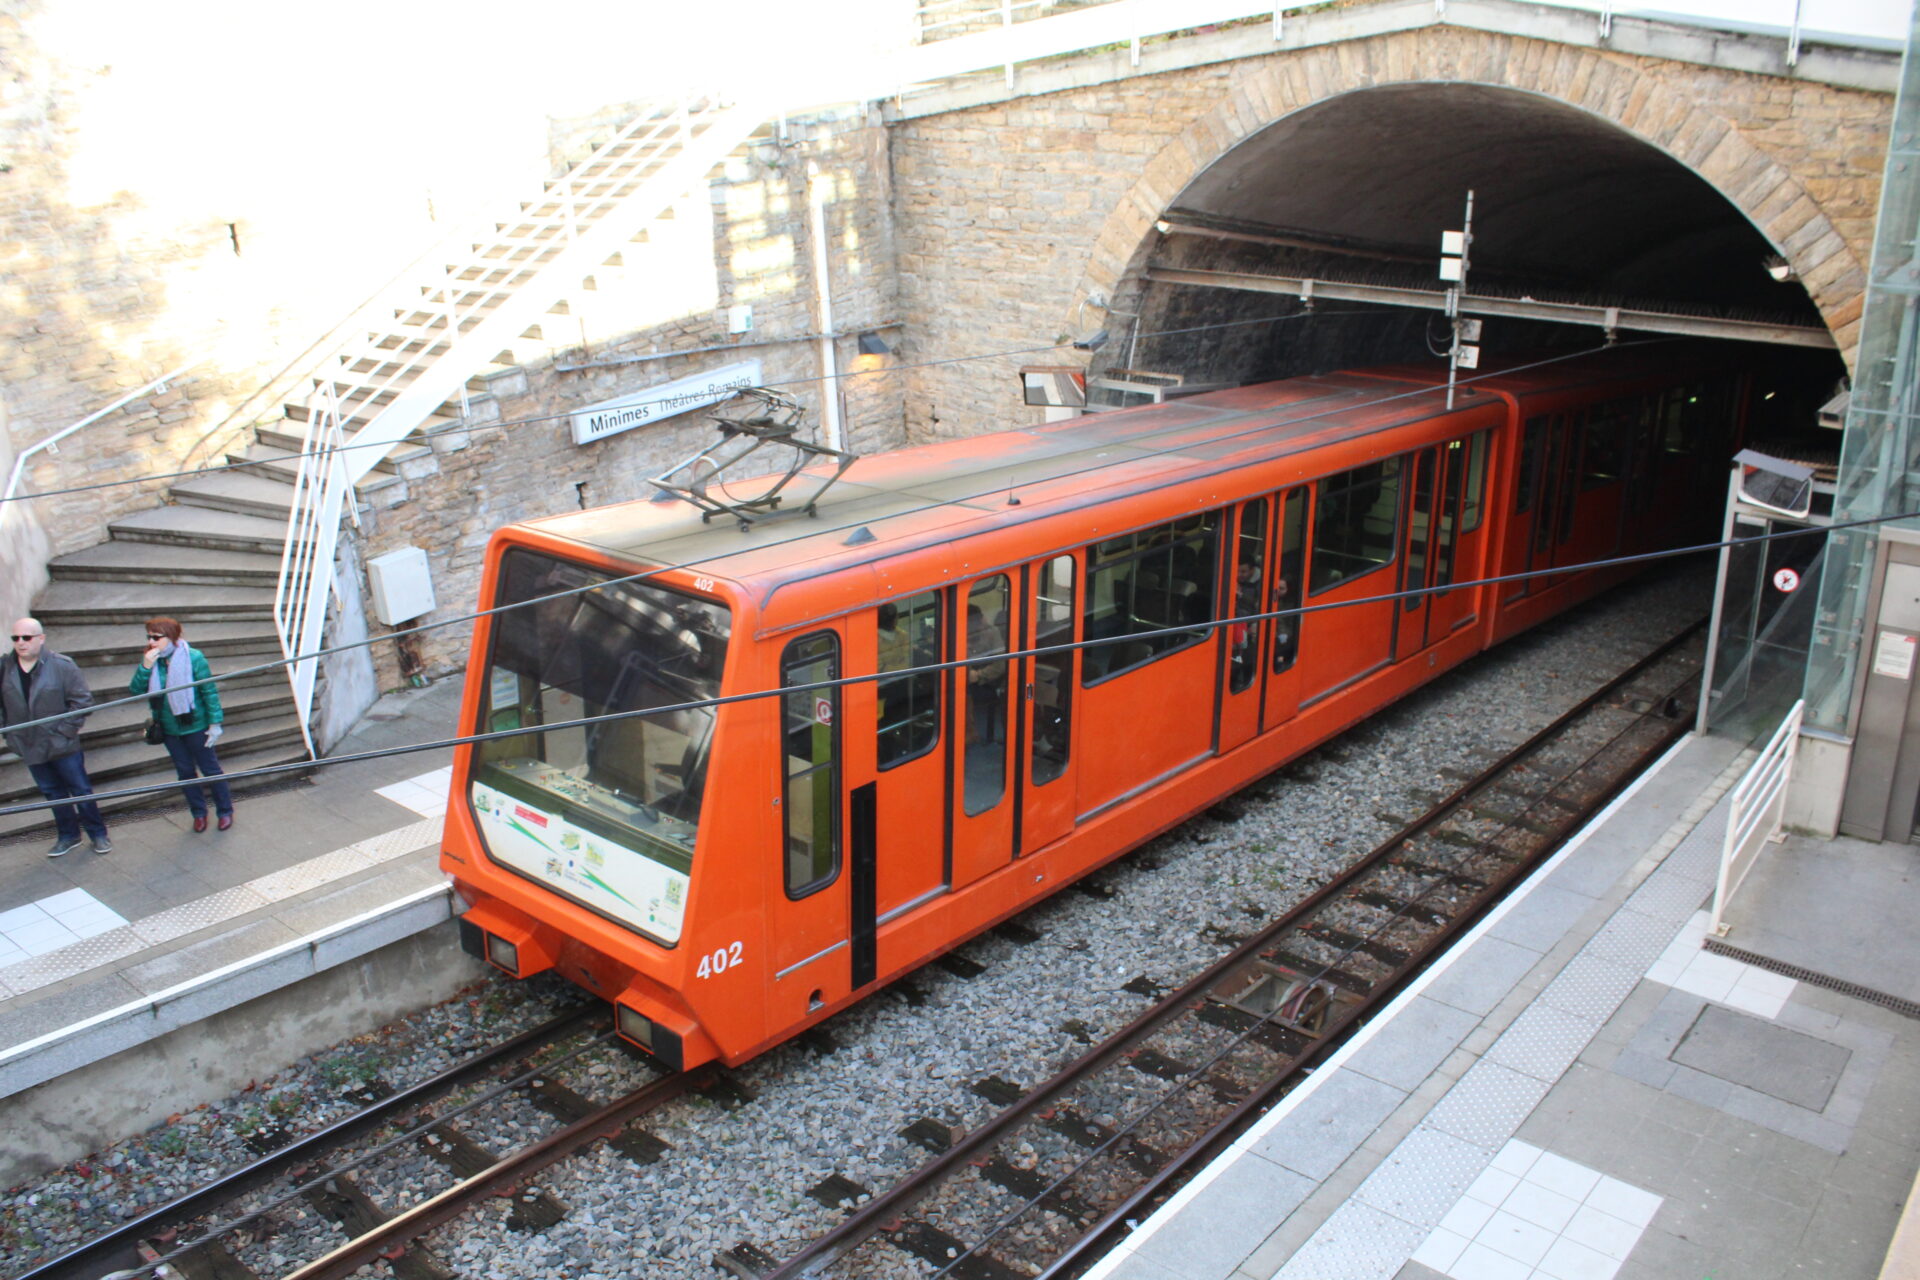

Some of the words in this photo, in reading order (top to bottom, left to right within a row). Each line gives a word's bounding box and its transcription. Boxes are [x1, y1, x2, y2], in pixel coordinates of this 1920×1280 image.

[590, 405, 649, 433] Minimes
[693, 577, 714, 593] 402
[696, 940, 744, 980] 402
